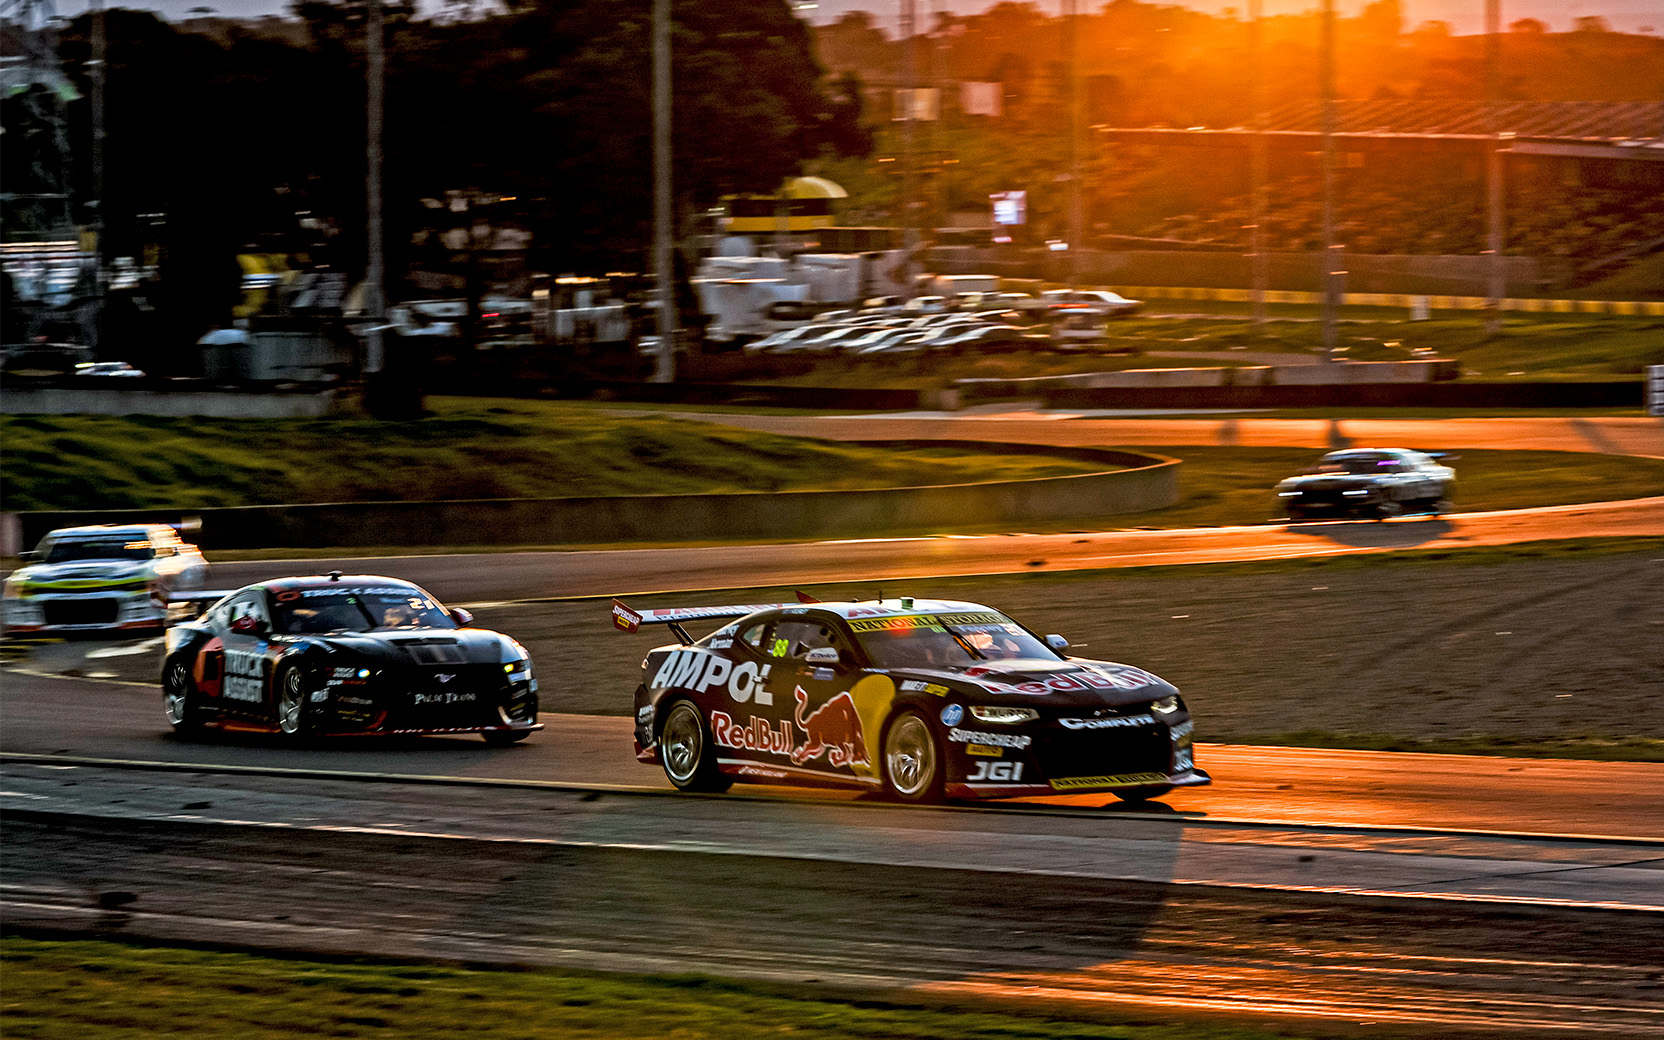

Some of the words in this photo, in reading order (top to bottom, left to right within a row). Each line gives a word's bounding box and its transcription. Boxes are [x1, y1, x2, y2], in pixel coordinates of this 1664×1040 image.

[855, 615, 938, 632] NATIONAL
[651, 649, 774, 706] AMPOL
[948, 727, 1033, 750] SUPERCHEAP
[966, 761, 1025, 782] JGI
